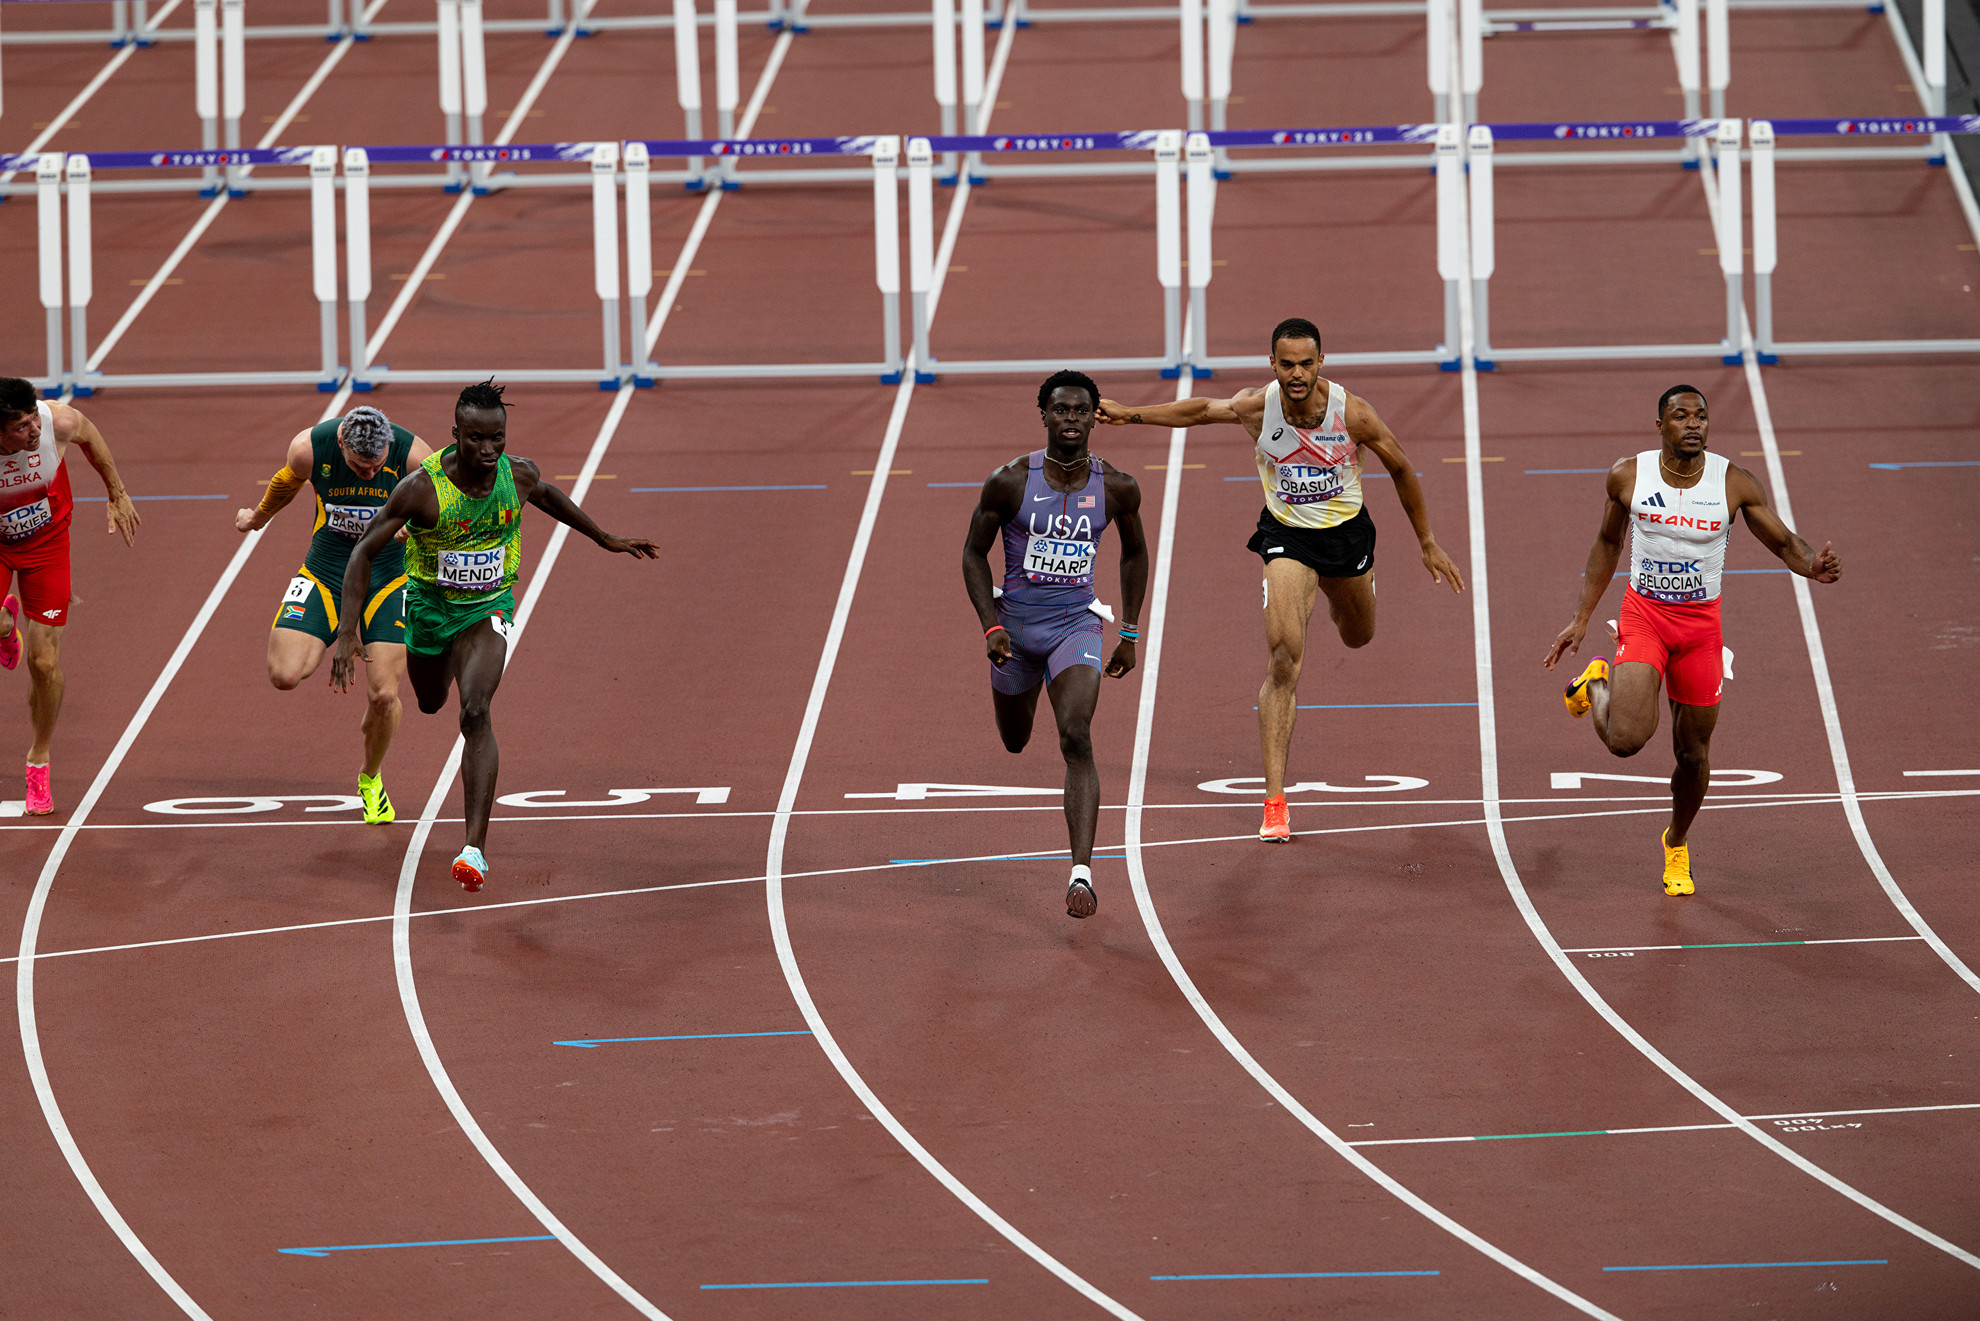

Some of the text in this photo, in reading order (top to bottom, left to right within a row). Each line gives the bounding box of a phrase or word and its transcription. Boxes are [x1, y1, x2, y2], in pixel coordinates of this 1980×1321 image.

[0, 471, 42, 488] OLSKA
[1292, 465, 1337, 478] TDK
[328, 487, 389, 498] SOUTH AFRICA
[1281, 476, 1339, 494] OBASUYI
[2, 502, 45, 522] TDK
[0, 511, 48, 533] ZYKIER
[332, 514, 365, 532] BARN
[1029, 512, 1092, 540] USA
[1638, 512, 1722, 532] FRANCE
[458, 549, 502, 566] TDK
[1049, 541, 1091, 557] TDK
[443, 563, 501, 582] MENDY
[1030, 554, 1088, 574] THARP
[1653, 560, 1700, 574] TDK
[1639, 573, 1703, 590] BELOCIAN
[42, 609, 62, 620] 4F
[844, 783, 1065, 800] 4
[1196, 775, 1430, 795] 3
[495, 786, 731, 808] 5
